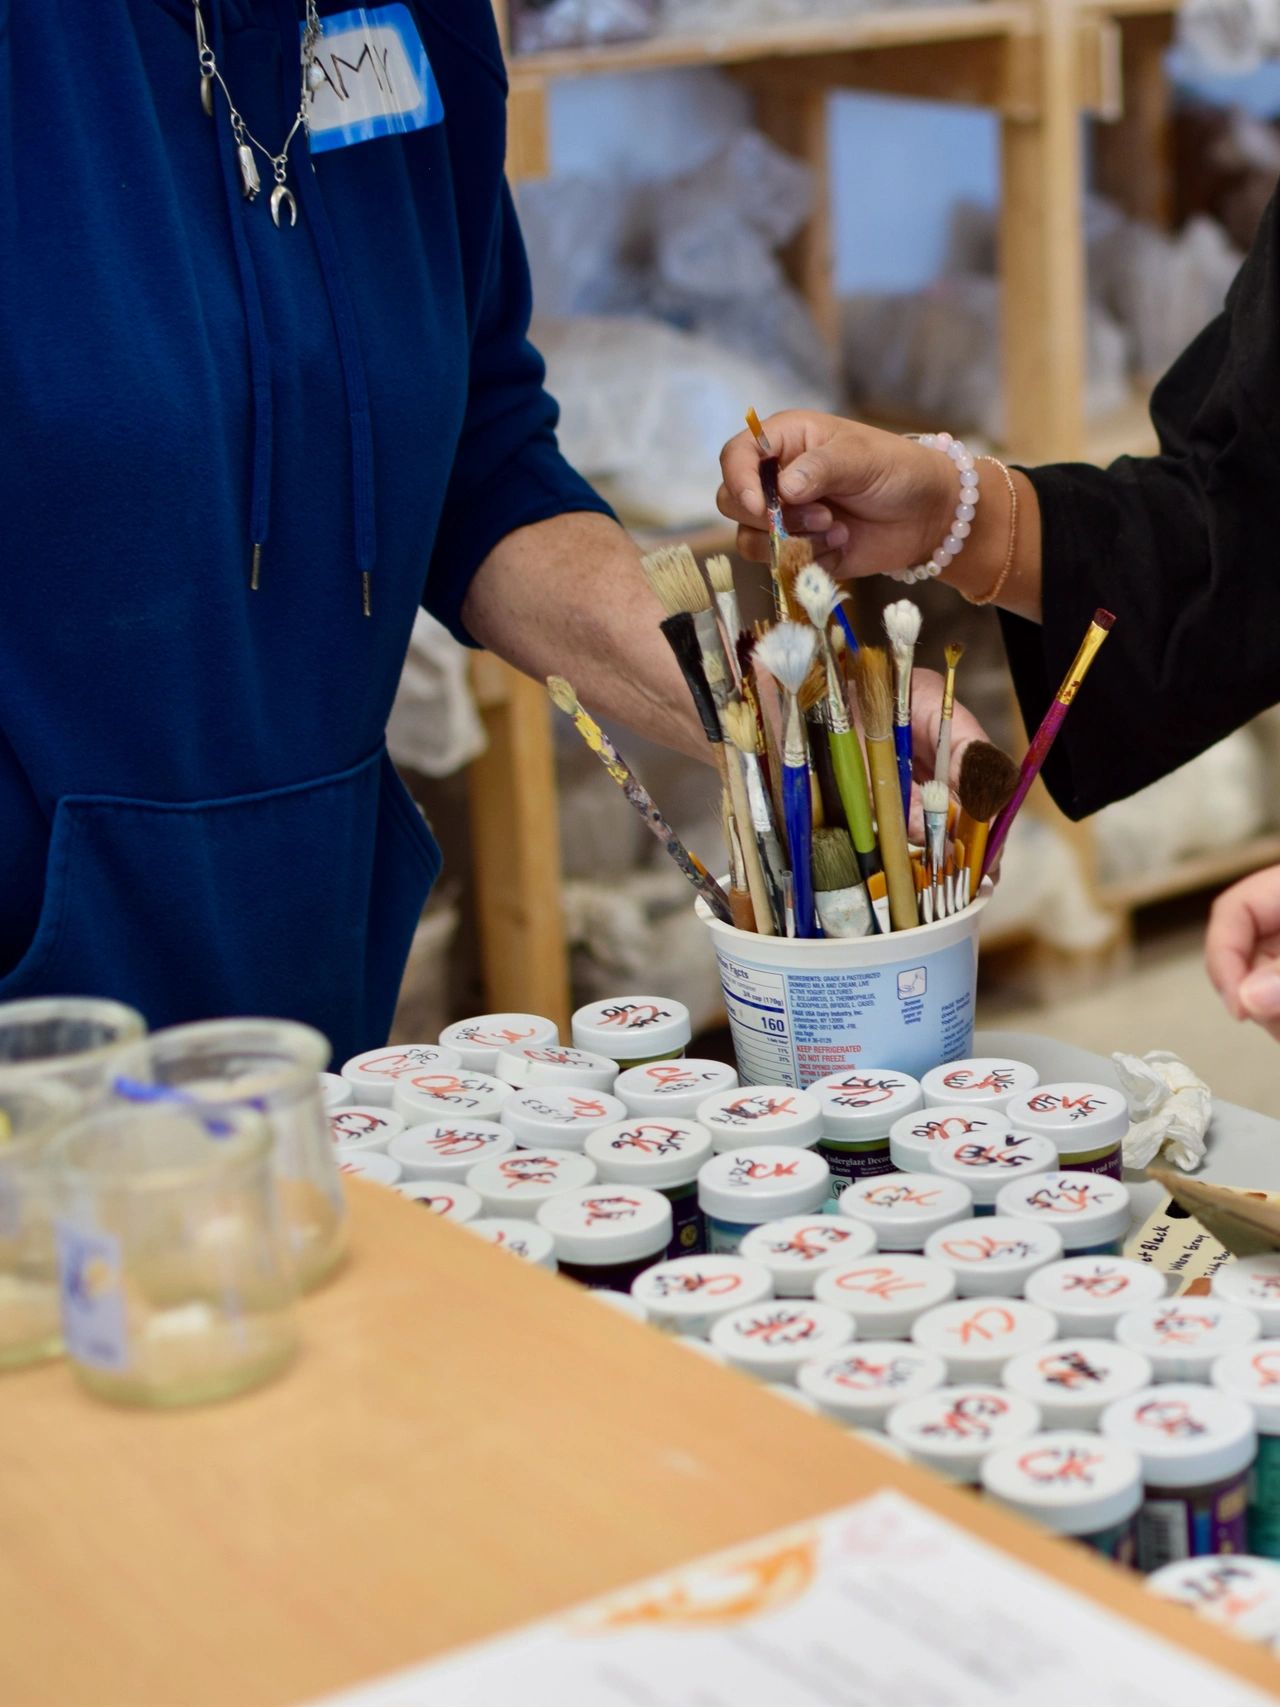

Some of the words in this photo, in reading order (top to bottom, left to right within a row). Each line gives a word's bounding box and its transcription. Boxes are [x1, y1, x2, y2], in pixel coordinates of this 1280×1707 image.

[761, 1016, 785, 1032] 160
[796, 1045, 812, 1053] KEEP
[814, 1045, 861, 1054] REFRIGERATED
[822, 1054, 846, 1062] FREEZE
[1140, 1225, 1170, 1251] Black
[1138, 1251, 1153, 1262] et
[1168, 1253, 1194, 1271] Warm
